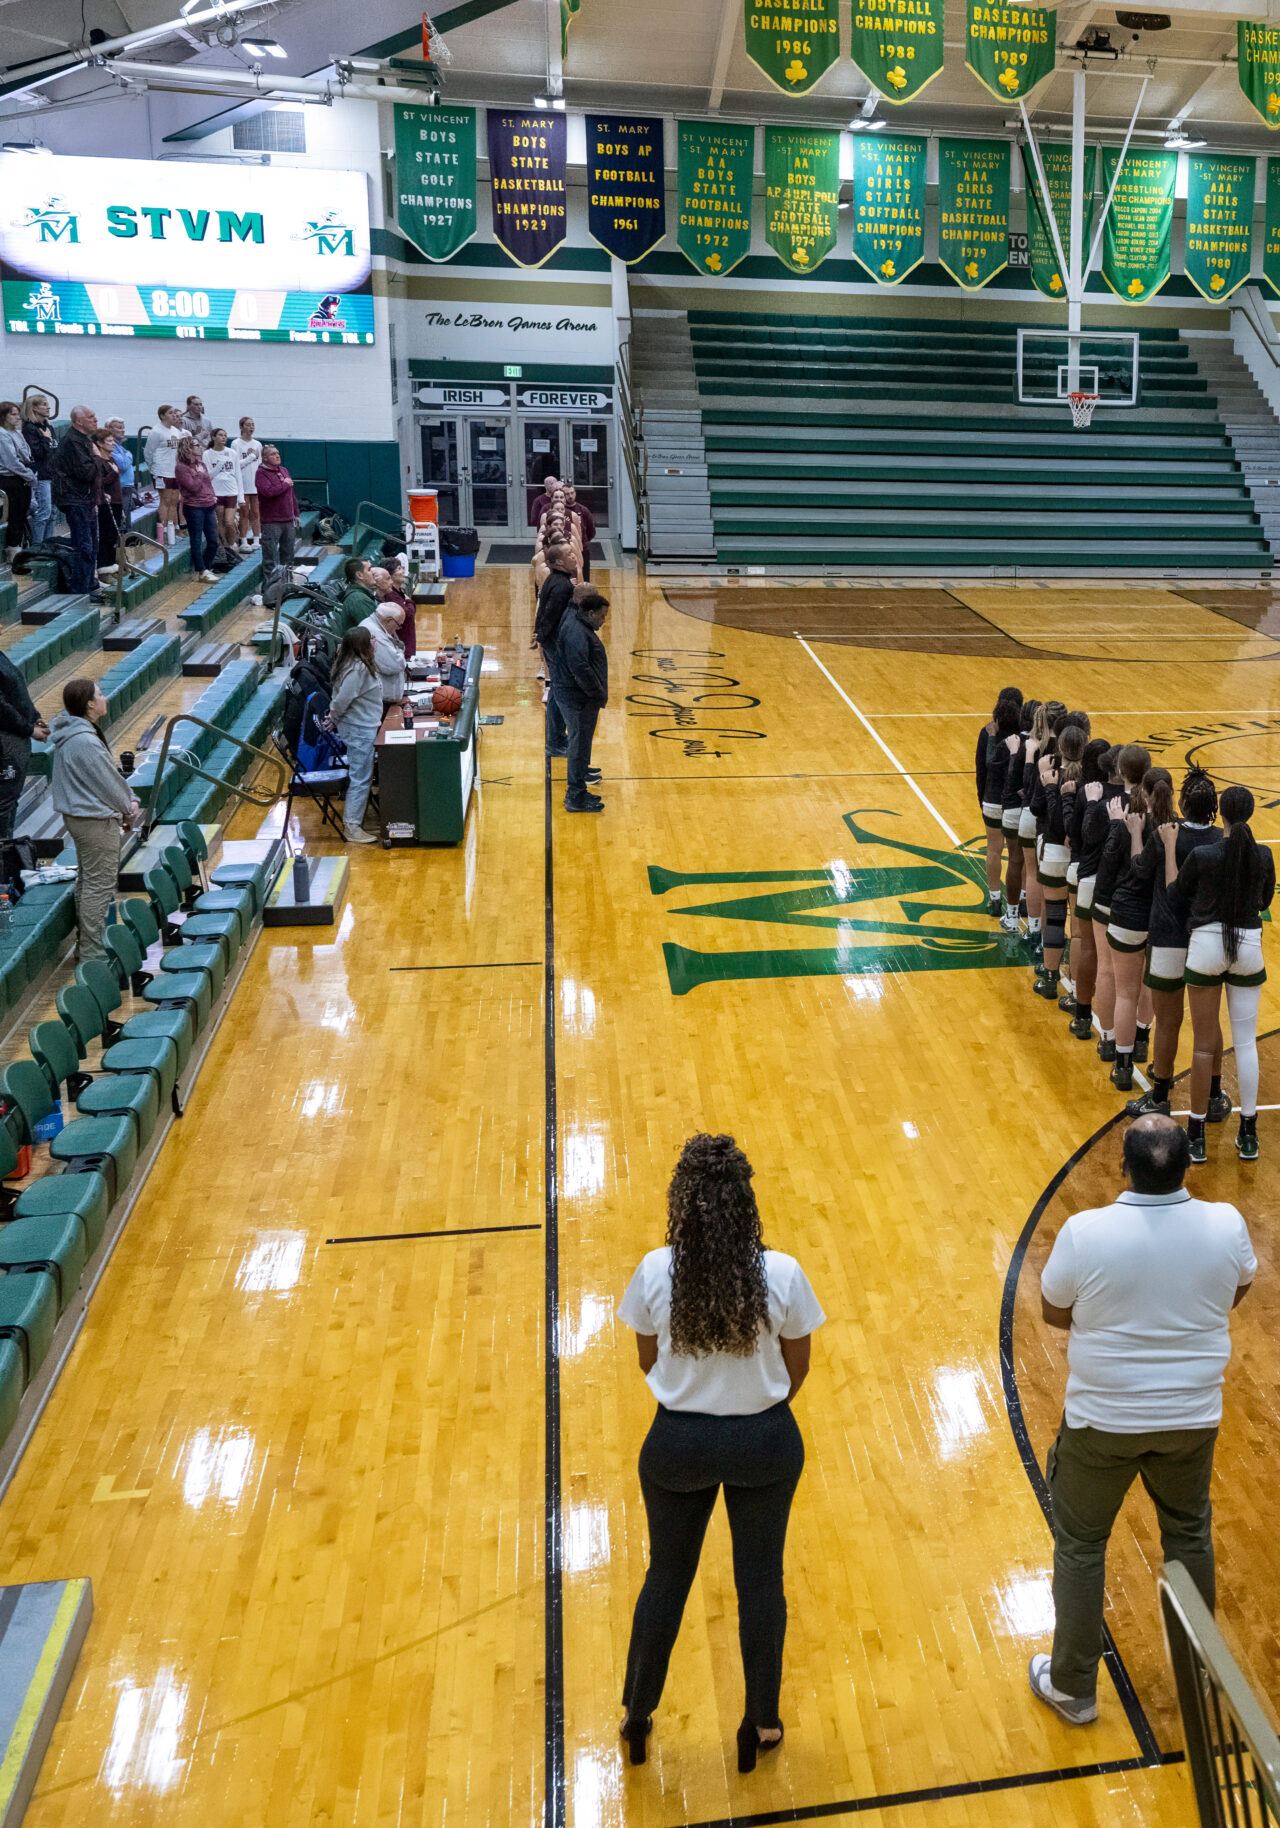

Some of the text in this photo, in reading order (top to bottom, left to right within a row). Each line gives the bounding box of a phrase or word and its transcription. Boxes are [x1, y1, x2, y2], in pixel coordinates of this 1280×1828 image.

[755, 0, 825, 11] BASEBALL
[859, 0, 932, 16] FOOTBALL
[973, 6, 1045, 27] BASEBALL
[751, 15, 837, 33] CHAMPIONS
[856, 15, 936, 34] CHAMPIONS
[971, 24, 1048, 43] CHAMPIONS
[776, 40, 811, 55] 1986
[880, 44, 915, 59] 1988
[994, 50, 1028, 66] 1989
[403, 111, 470, 124] ST VINCENT
[502, 119, 554, 129] ST. MARY
[597, 124, 649, 134] ST. MARY
[420, 129, 456, 143] BOYS
[513, 136, 546, 149] BOYS
[699, 135, 748, 147] VINCENT
[597, 143, 652, 156] BOYS AP
[710, 147, 744, 156] MARY
[416, 151, 458, 165] STATE
[511, 156, 549, 169] STATE
[707, 156, 725, 169] AA
[876, 164, 902, 176] AAA
[1126, 159, 1170, 171] VINCENT
[421, 174, 454, 186] GOLF
[595, 169, 655, 183] FOOTBALL
[698, 168, 733, 181] BOYS
[964, 171, 987, 182] AAA
[1133, 169, 1162, 179] MARY
[494, 178, 564, 191] BASKETBALL
[693, 182, 736, 196] STATE
[867, 176, 911, 190] GIRLS
[957, 183, 993, 194] GIRLS
[1112, 183, 1165, 196] WRESTLING
[1210, 182, 1232, 193] AAA
[400, 194, 472, 209] CHAMPIONS
[591, 195, 660, 209] CHAMPIONS
[865, 191, 910, 204] STATE
[956, 197, 992, 209] STATE
[1128, 194, 1173, 207] CHAMPIONS
[1204, 194, 1238, 206] GIRLS
[497, 203, 565, 216] CHAMPIONS
[685, 197, 742, 213] FOOTBALL
[859, 206, 920, 219] SOFTBALL
[942, 212, 1007, 225] BASKETBALL
[1203, 209, 1236, 220] STATE
[106, 205, 265, 244] STVM
[423, 214, 453, 226] 1927
[516, 219, 546, 231] 1929
[614, 218, 638, 230] 1961
[680, 214, 749, 230] CHAMPIONS
[857, 222, 922, 237] CHAMPIONS
[942, 229, 1005, 242] CHAMPIONS
[1189, 223, 1249, 236] BASKETBALL
[697, 234, 728, 246] 1972
[873, 239, 902, 251] 1979
[1188, 239, 1247, 252] CHAMPIONS
[1206, 257, 1231, 269] 1980
[151, 289, 210, 320] 8:00
[425, 312, 597, 332] The LeBron James Arena
[443, 390, 483, 403] IRISH
[530, 392, 598, 406] FOREVER
[648, 727, 768, 759] Court
